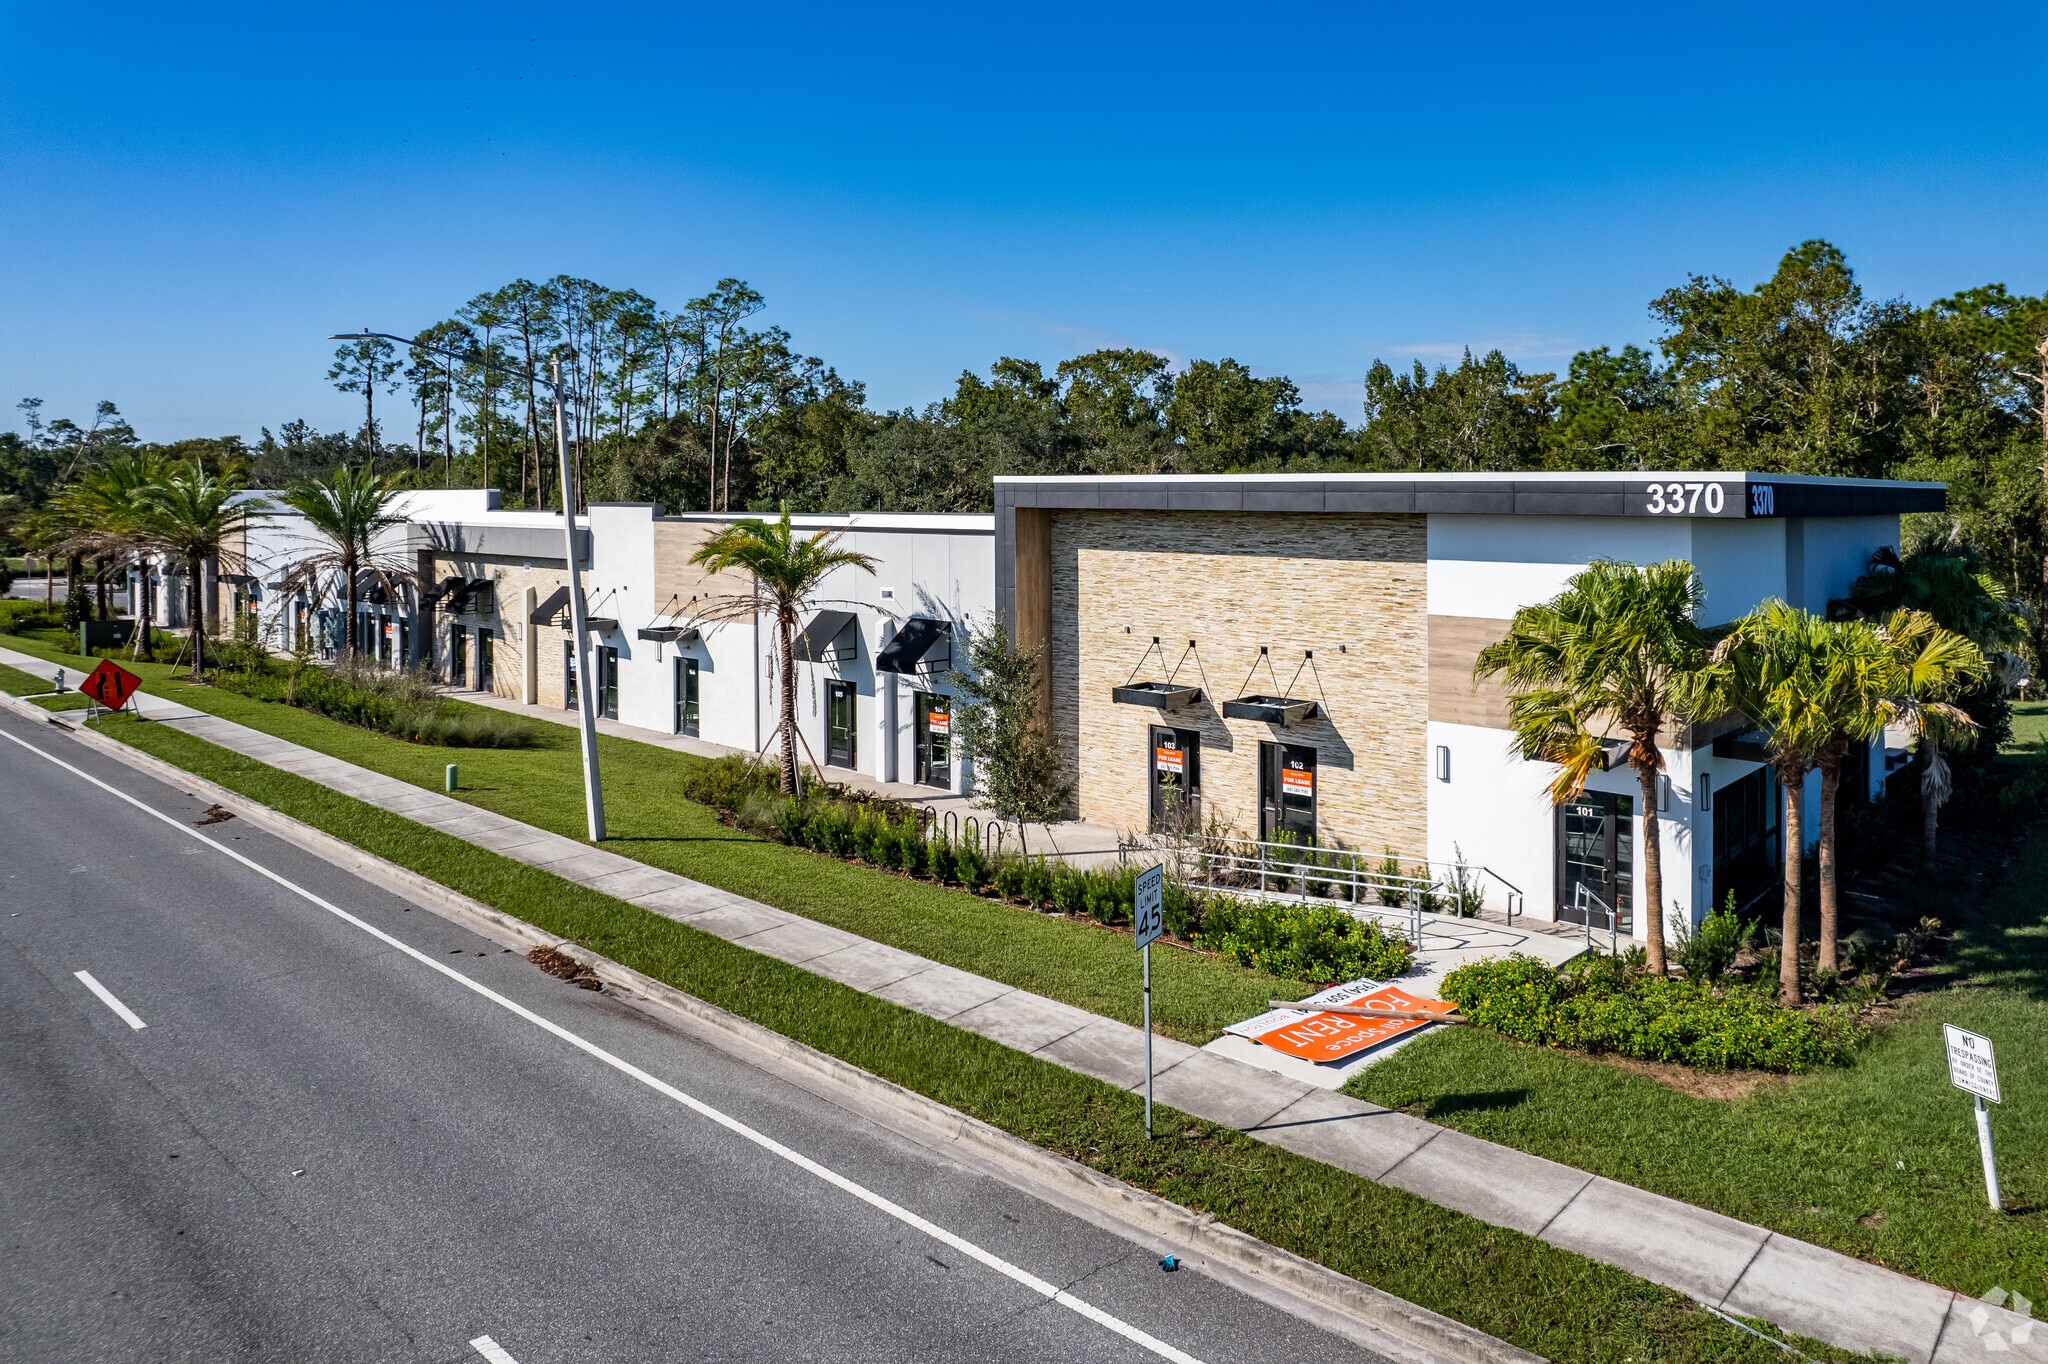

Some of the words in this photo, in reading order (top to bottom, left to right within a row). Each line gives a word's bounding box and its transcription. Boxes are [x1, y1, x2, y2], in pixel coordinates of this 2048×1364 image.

[1646, 482, 1725, 514] 3370
[1752, 484, 1774, 516] 3370
[1163, 741, 1176, 750] 103
[1290, 760, 1304, 770] 102
[1295, 778, 1311, 786] LEASE
[1576, 806, 1594, 817] 101
[1138, 873, 1161, 896] SPEED
[1140, 889, 1158, 910] LIMIT
[1138, 903, 1160, 937] 45
[1342, 980, 1379, 996] (954)
[1279, 1015, 1356, 1047] RENT
[1325, 1028, 1387, 1051] Space
[1962, 1034, 1975, 1049] NO
[1950, 1045, 1992, 1069] TRESPASSING
